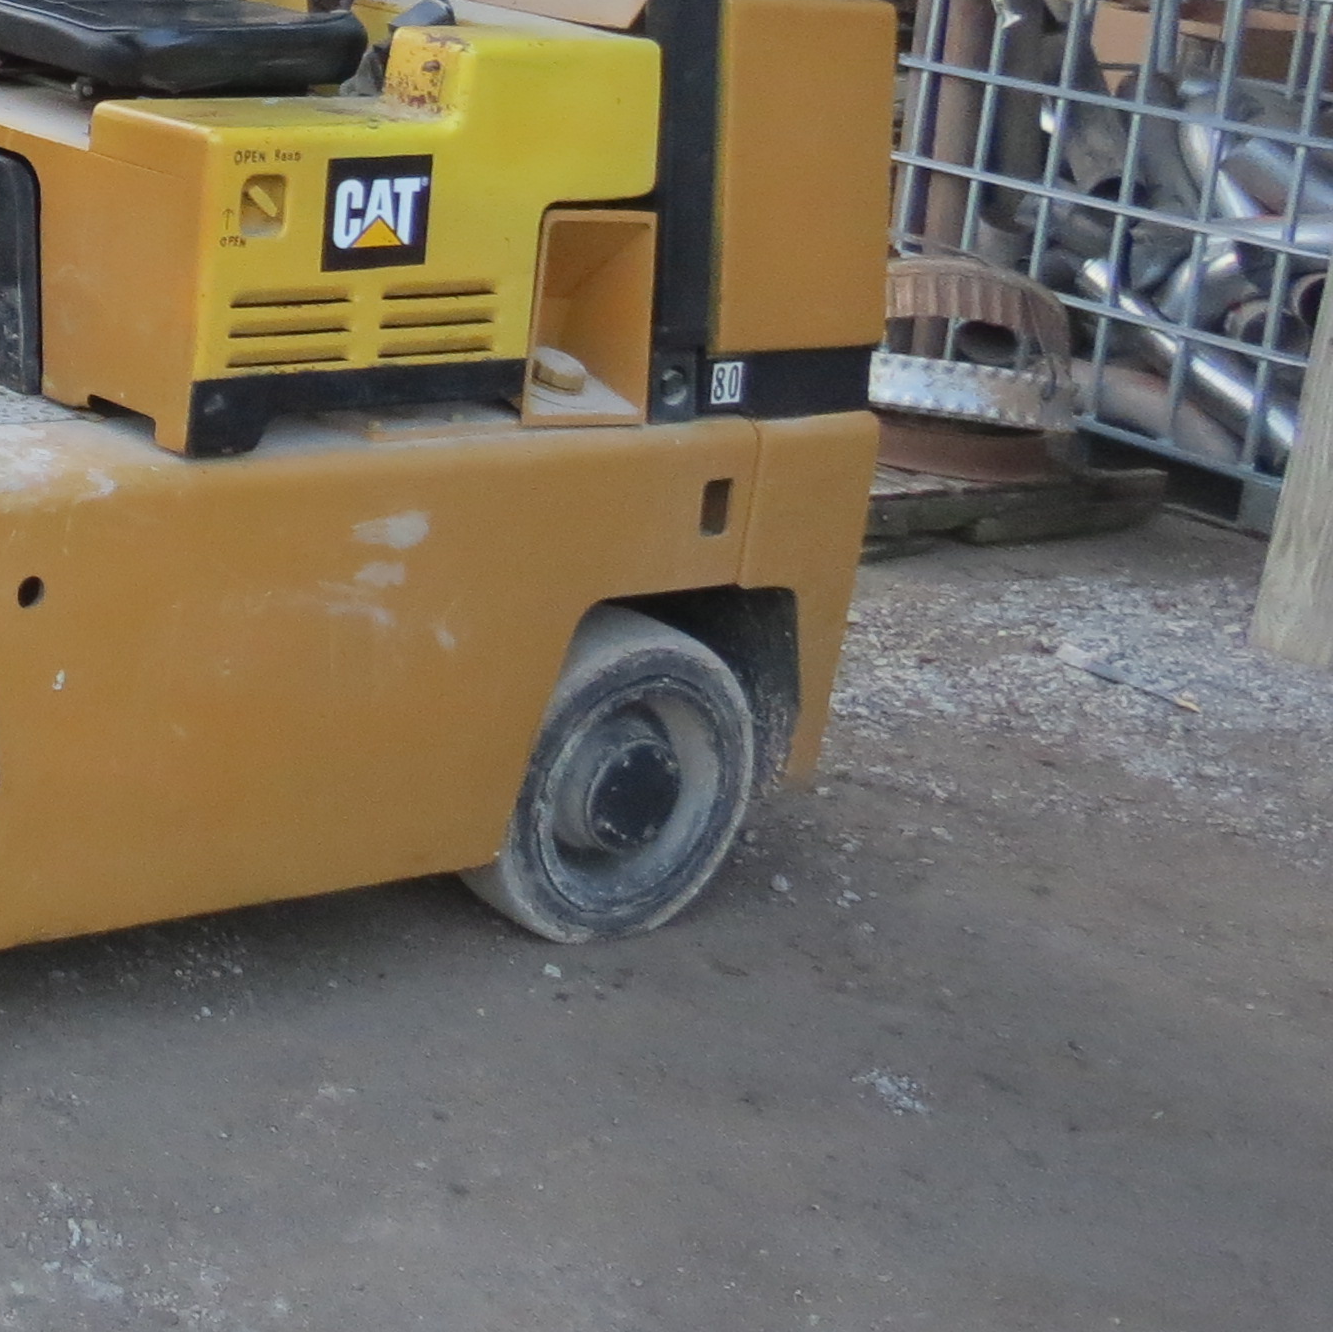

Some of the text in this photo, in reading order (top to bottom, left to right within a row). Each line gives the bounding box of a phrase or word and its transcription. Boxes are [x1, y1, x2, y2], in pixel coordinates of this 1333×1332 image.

[234, 150, 266, 165] OPEN
[333, 177, 421, 249] CAT
[714, 365, 739, 401] 80
